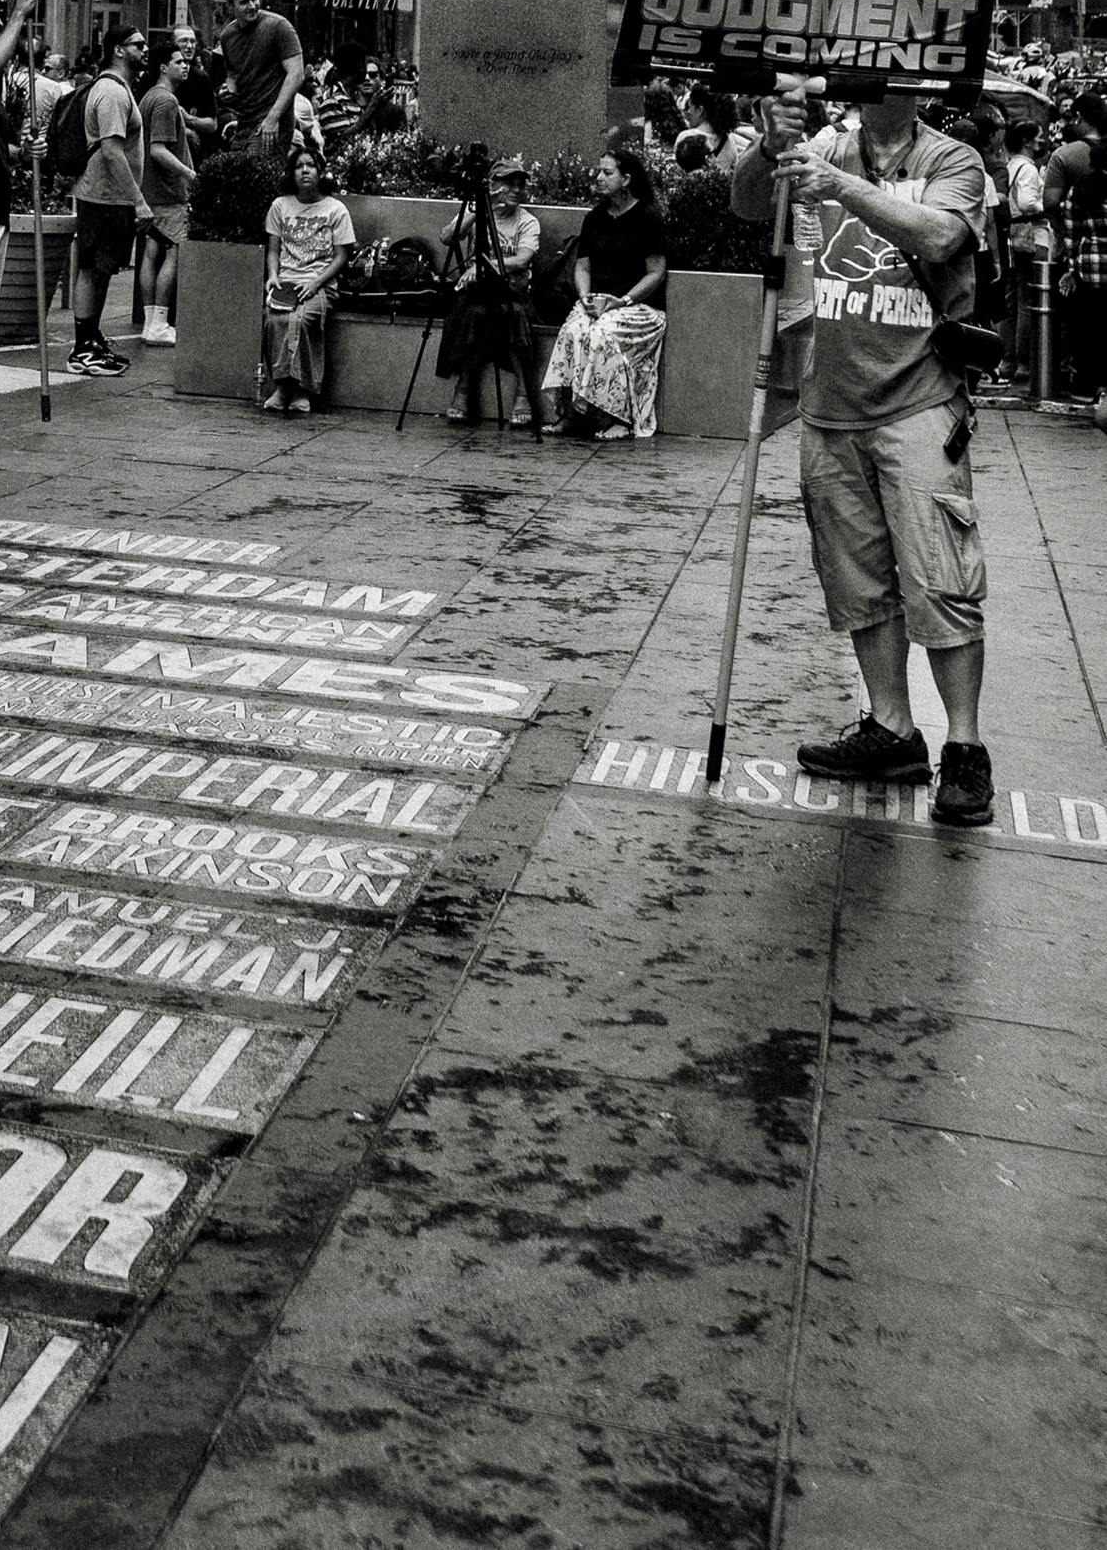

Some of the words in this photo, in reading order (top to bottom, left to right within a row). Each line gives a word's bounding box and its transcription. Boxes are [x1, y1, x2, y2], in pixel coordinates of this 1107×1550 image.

[638, 23, 703, 54] IS
[719, 32, 967, 73] COMING
[846, 290, 869, 315] or
[869, 283, 934, 329] PERISH
[13, 605, 401, 652] AIRLINES
[38, 593, 405, 642] AMERICAN
[139, 690, 504, 748] MAJESTIC
[48, 807, 418, 876] BROOKS
[16, 835, 402, 907] ATKINSON
